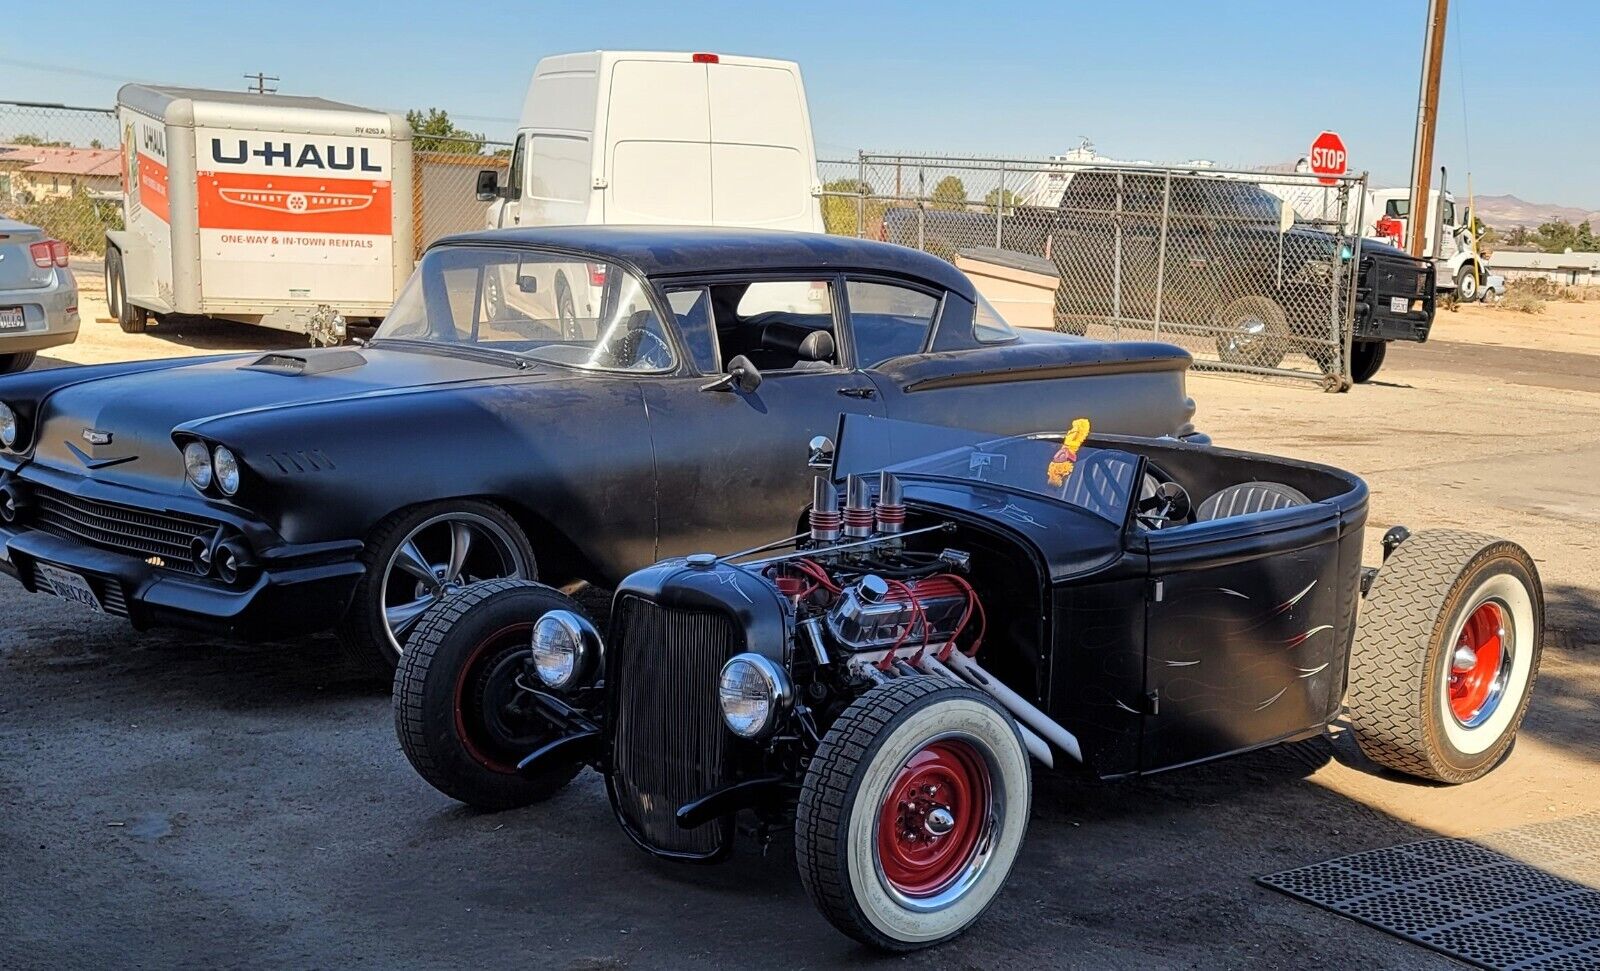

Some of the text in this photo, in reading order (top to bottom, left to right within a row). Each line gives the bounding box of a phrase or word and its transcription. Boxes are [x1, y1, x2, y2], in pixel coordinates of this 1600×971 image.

[211, 138, 382, 172] U-HAUL
[1312, 147, 1345, 170] STOP
[240, 194, 353, 205] FINEST SAFEST
[221, 235, 373, 248] ONE-WAY & IN-TOWN RENTALS
